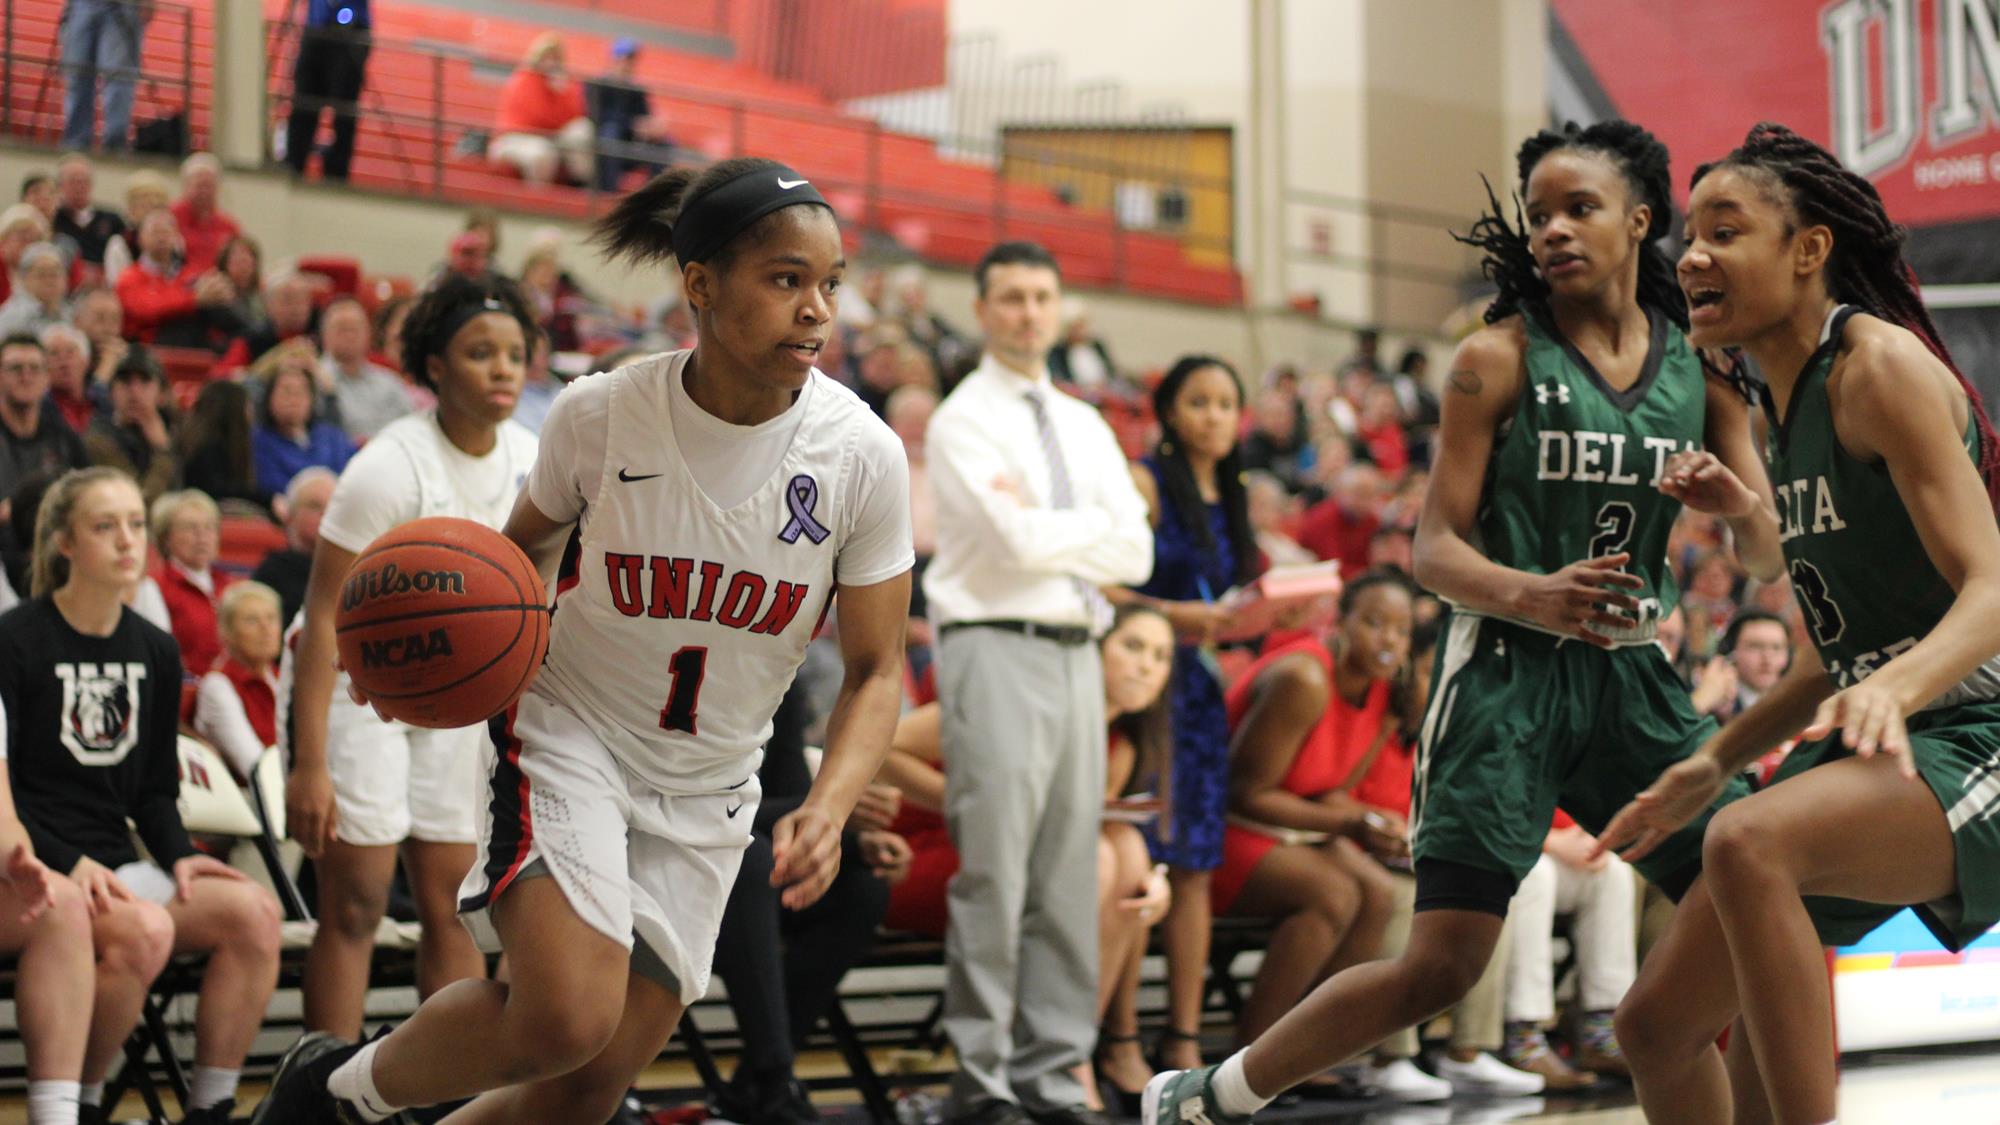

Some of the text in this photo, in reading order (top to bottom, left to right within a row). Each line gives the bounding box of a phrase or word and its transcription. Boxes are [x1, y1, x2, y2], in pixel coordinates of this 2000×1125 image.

[1913, 154, 1984, 191] HOME
[1537, 430, 1695, 487] DELT
[1588, 501, 1636, 576] 2
[1777, 476, 1846, 543] LTA
[343, 563, 466, 612] Wilson
[605, 552, 809, 636] UNION
[360, 627, 453, 668] NCAA
[659, 645, 708, 736] 1
